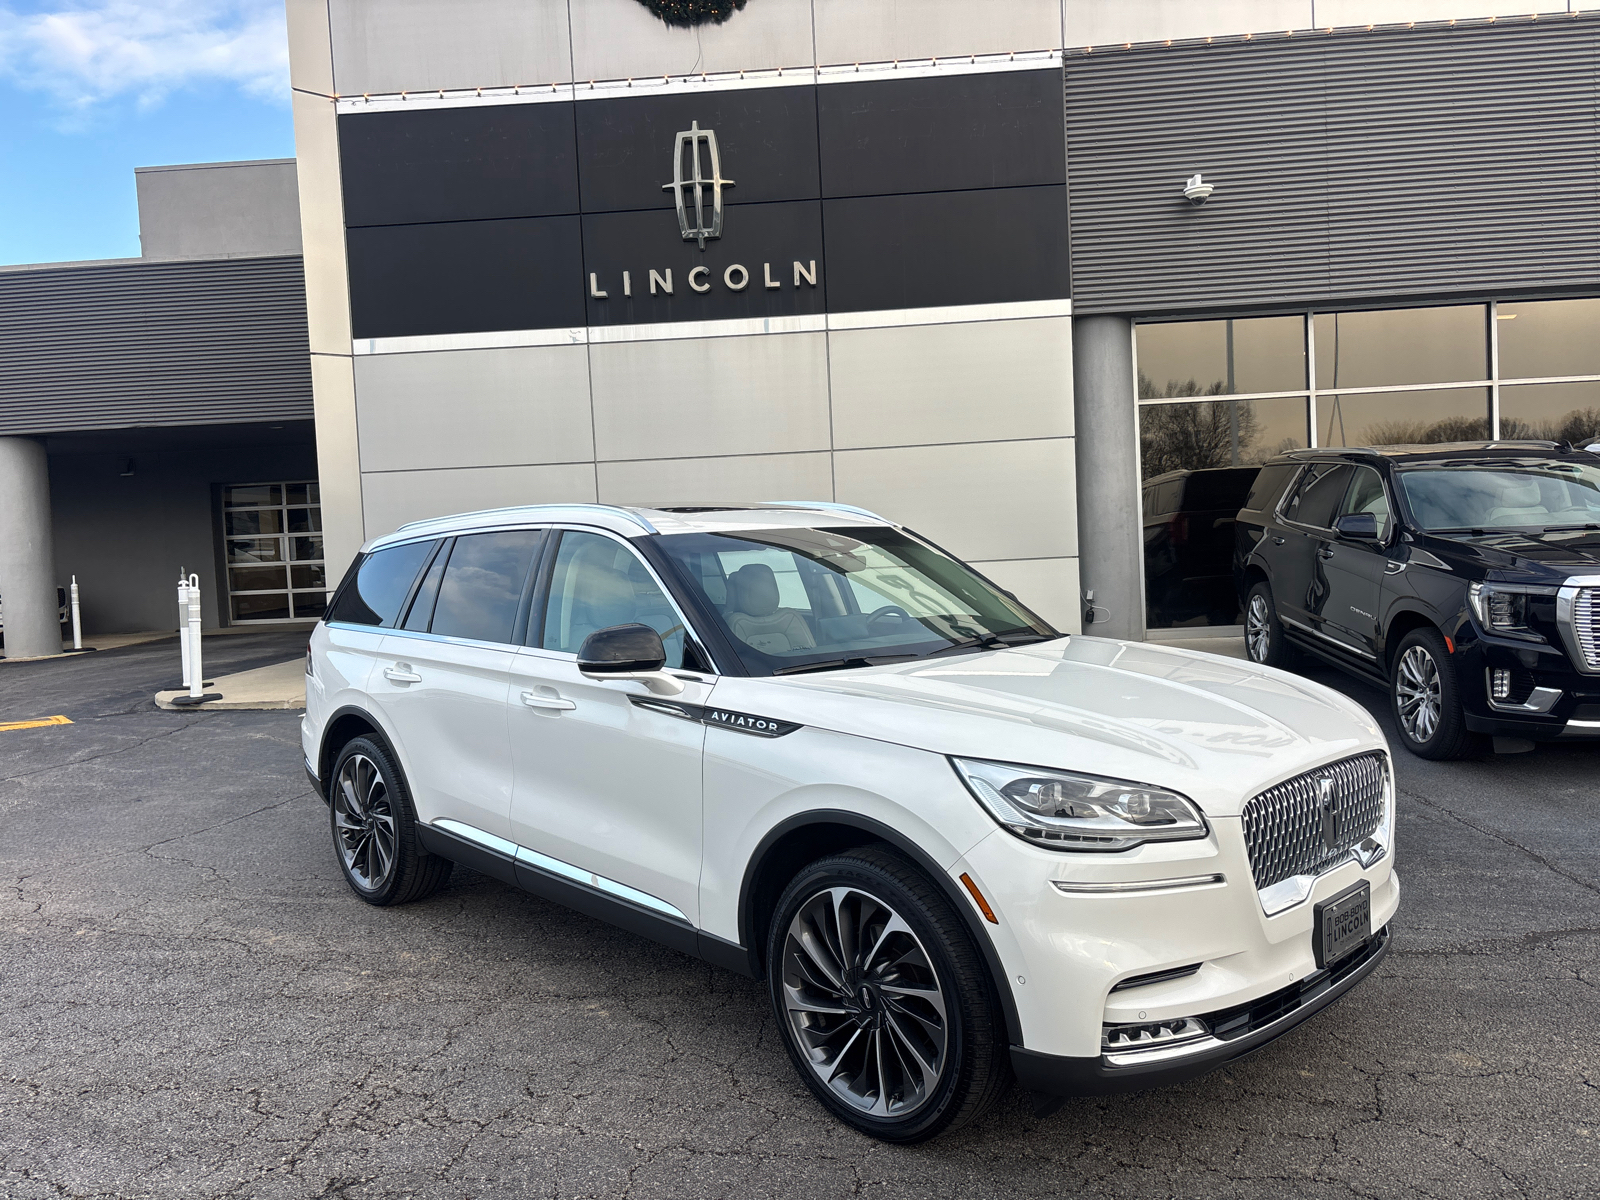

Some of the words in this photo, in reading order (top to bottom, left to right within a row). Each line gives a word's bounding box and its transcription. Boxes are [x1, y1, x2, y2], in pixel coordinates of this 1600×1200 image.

[590, 260, 817, 298] LINCOLN
[711, 712, 779, 731] AVIATOR
[1333, 911, 1369, 942] LINCOLN
